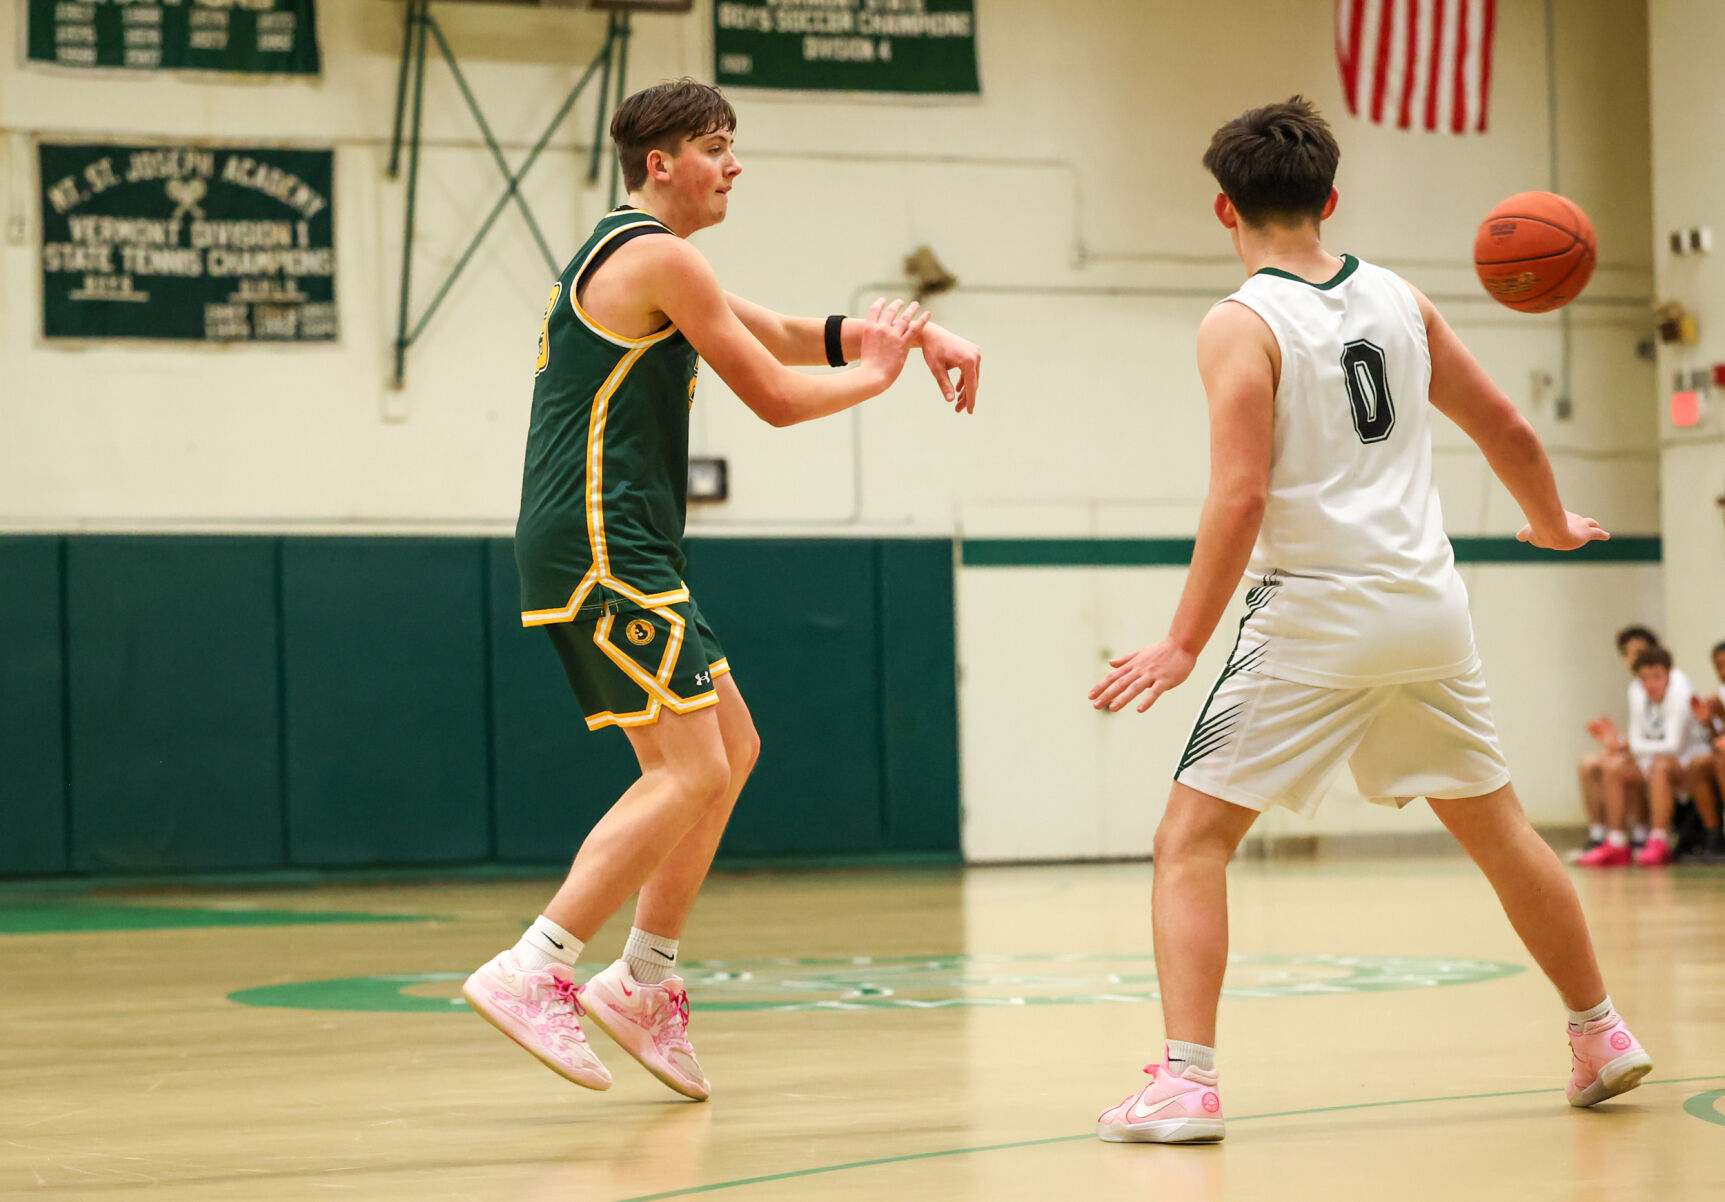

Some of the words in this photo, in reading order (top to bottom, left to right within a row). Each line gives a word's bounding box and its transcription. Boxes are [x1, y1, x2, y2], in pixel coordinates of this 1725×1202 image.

[775, 8, 855, 33] SOCCER
[858, 12, 973, 37] CHAMPIONS
[802, 36, 876, 62] DIVISION
[125, 150, 215, 183] JOSEPH
[221, 154, 327, 218] ACADEMY
[69, 215, 180, 247] VERMONT
[190, 219, 292, 249] DIVISION
[44, 243, 114, 273] STATE
[122, 247, 204, 277] TENNIS
[206, 248, 335, 277] CHAMPIONS
[1340, 338, 1395, 444] 0
